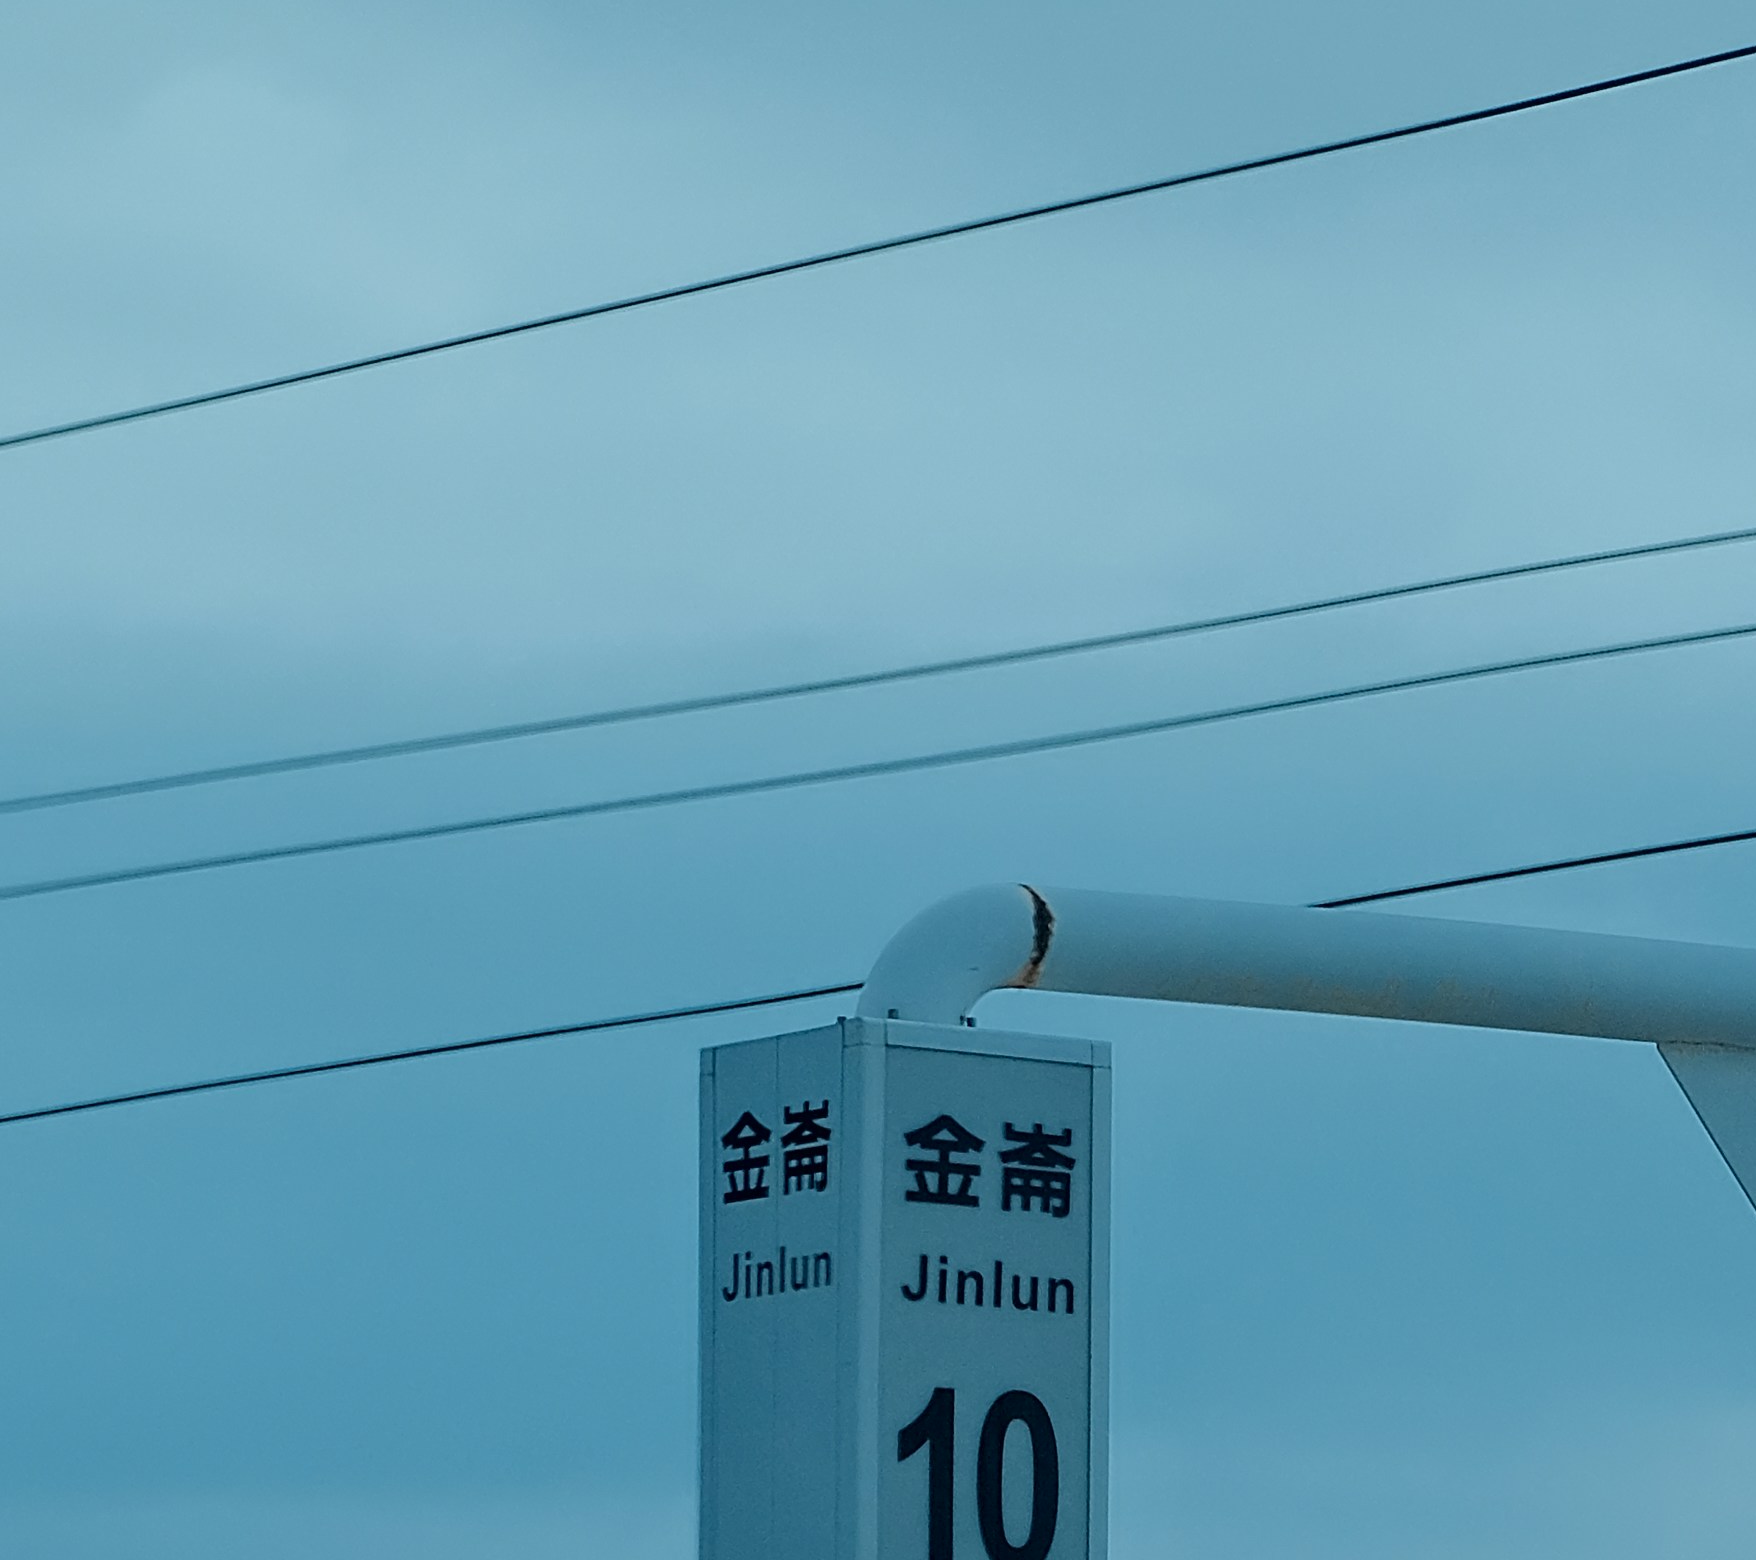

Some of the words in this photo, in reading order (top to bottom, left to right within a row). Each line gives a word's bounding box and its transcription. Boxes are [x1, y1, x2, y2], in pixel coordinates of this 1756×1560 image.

[721, 1100, 832, 1205] 金崙
[903, 1114, 1076, 1219] 金崙
[722, 1246, 832, 1302] Jinlun
[900, 1254, 1075, 1315] Jinlun
